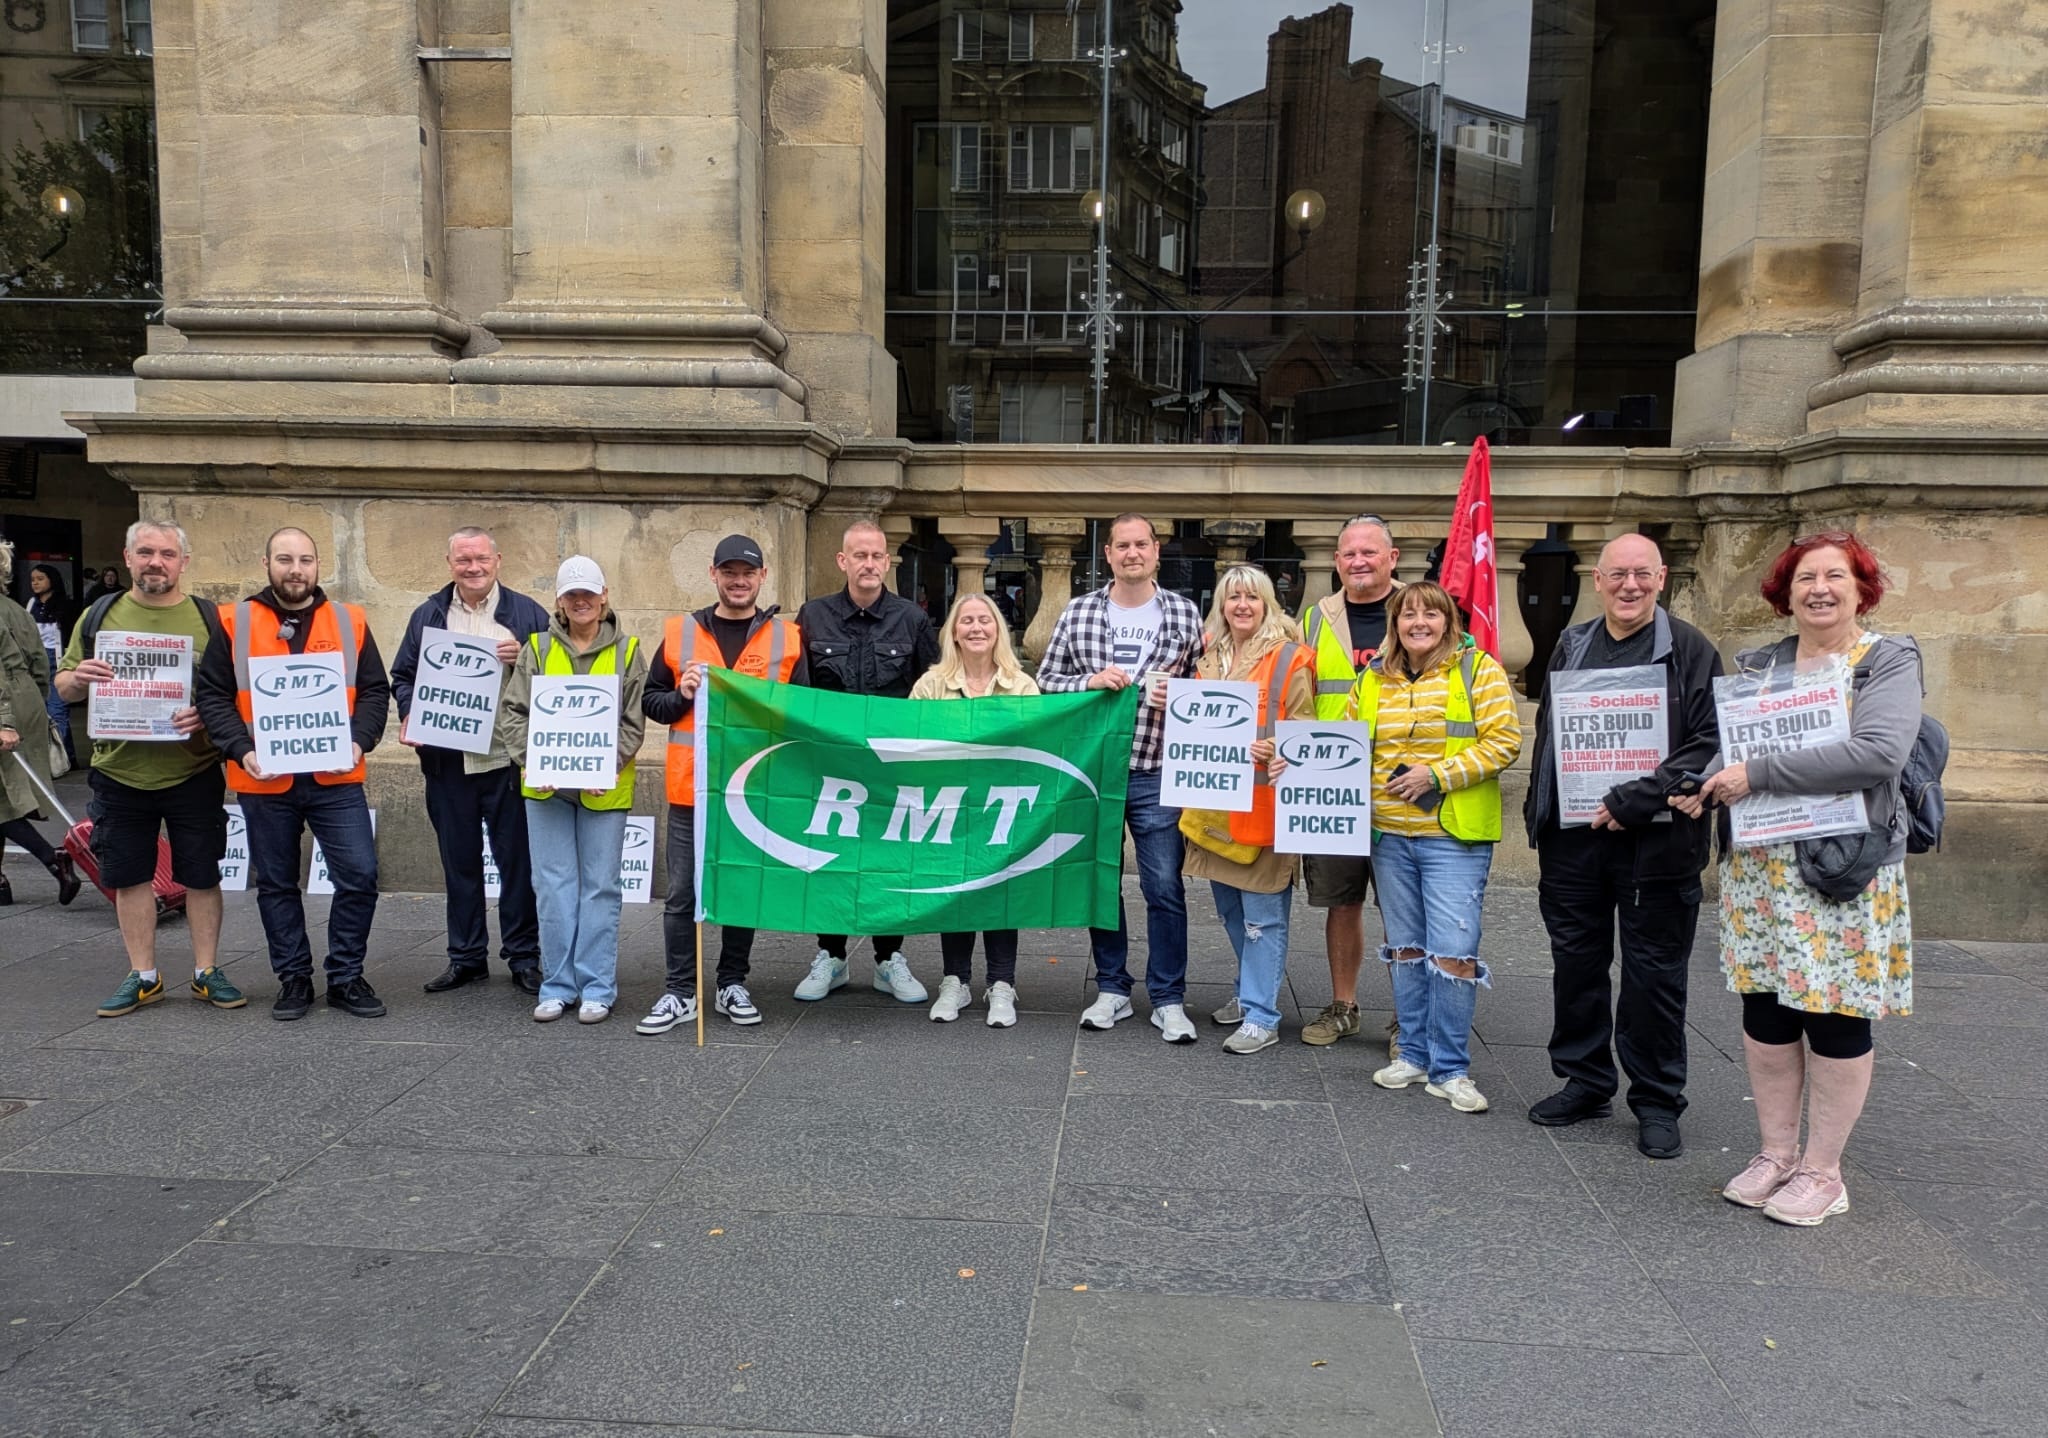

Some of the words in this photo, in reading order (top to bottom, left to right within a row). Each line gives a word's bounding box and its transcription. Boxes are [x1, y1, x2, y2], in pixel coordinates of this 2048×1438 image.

[126, 636, 186, 649] Socialist
[136, 652, 179, 667] BUILD
[440, 651, 487, 669] RMT
[112, 666, 157, 681] PARTY
[273, 674, 325, 690] RMT
[131, 681, 142, 689] ON
[96, 688, 143, 697] AUSTERITY
[144, 689, 161, 698] AND
[163, 690, 183, 700] WAR
[418, 685, 493, 712] OFFICIAL
[551, 696, 600, 708] RMT
[1589, 694, 1660, 708] Socialist
[1759, 687, 1838, 714] Socialist
[1188, 702, 1238, 718] RMT
[258, 711, 345, 732] OFFICIAL
[421, 710, 483, 735] PICKET
[1560, 715, 1600, 732] LET'S
[1604, 713, 1653, 731] BUILD
[1728, 720, 1772, 745] LET'S
[1777, 709, 1832, 733] BUILD
[270, 736, 338, 756] PICKET
[533, 731, 613, 748] OFFICIAL
[1561, 734, 1571, 750] A
[1575, 732, 1628, 750] PARTY
[1730, 745, 1743, 763] A
[1746, 733, 1803, 759] PARTY
[1168, 743, 1250, 764] OFFICIAL
[1297, 745, 1349, 759] RMT
[1562, 751, 1573, 761] TO
[1576, 751, 1597, 760] TAKE
[1600, 750, 1612, 760] ON
[540, 756, 604, 771] PICKET
[1562, 761, 1613, 772] AUSTERITY
[1615, 760, 1635, 771] AND
[1637, 760, 1660, 770] WAR
[1175, 770, 1241, 791] PICKET
[1280, 787, 1365, 806] OFFICIAL
[802, 775, 1041, 845] RMT
[1288, 815, 1357, 835] PICKET
[621, 859, 649, 871] CIAL
[620, 878, 643, 890] KET
